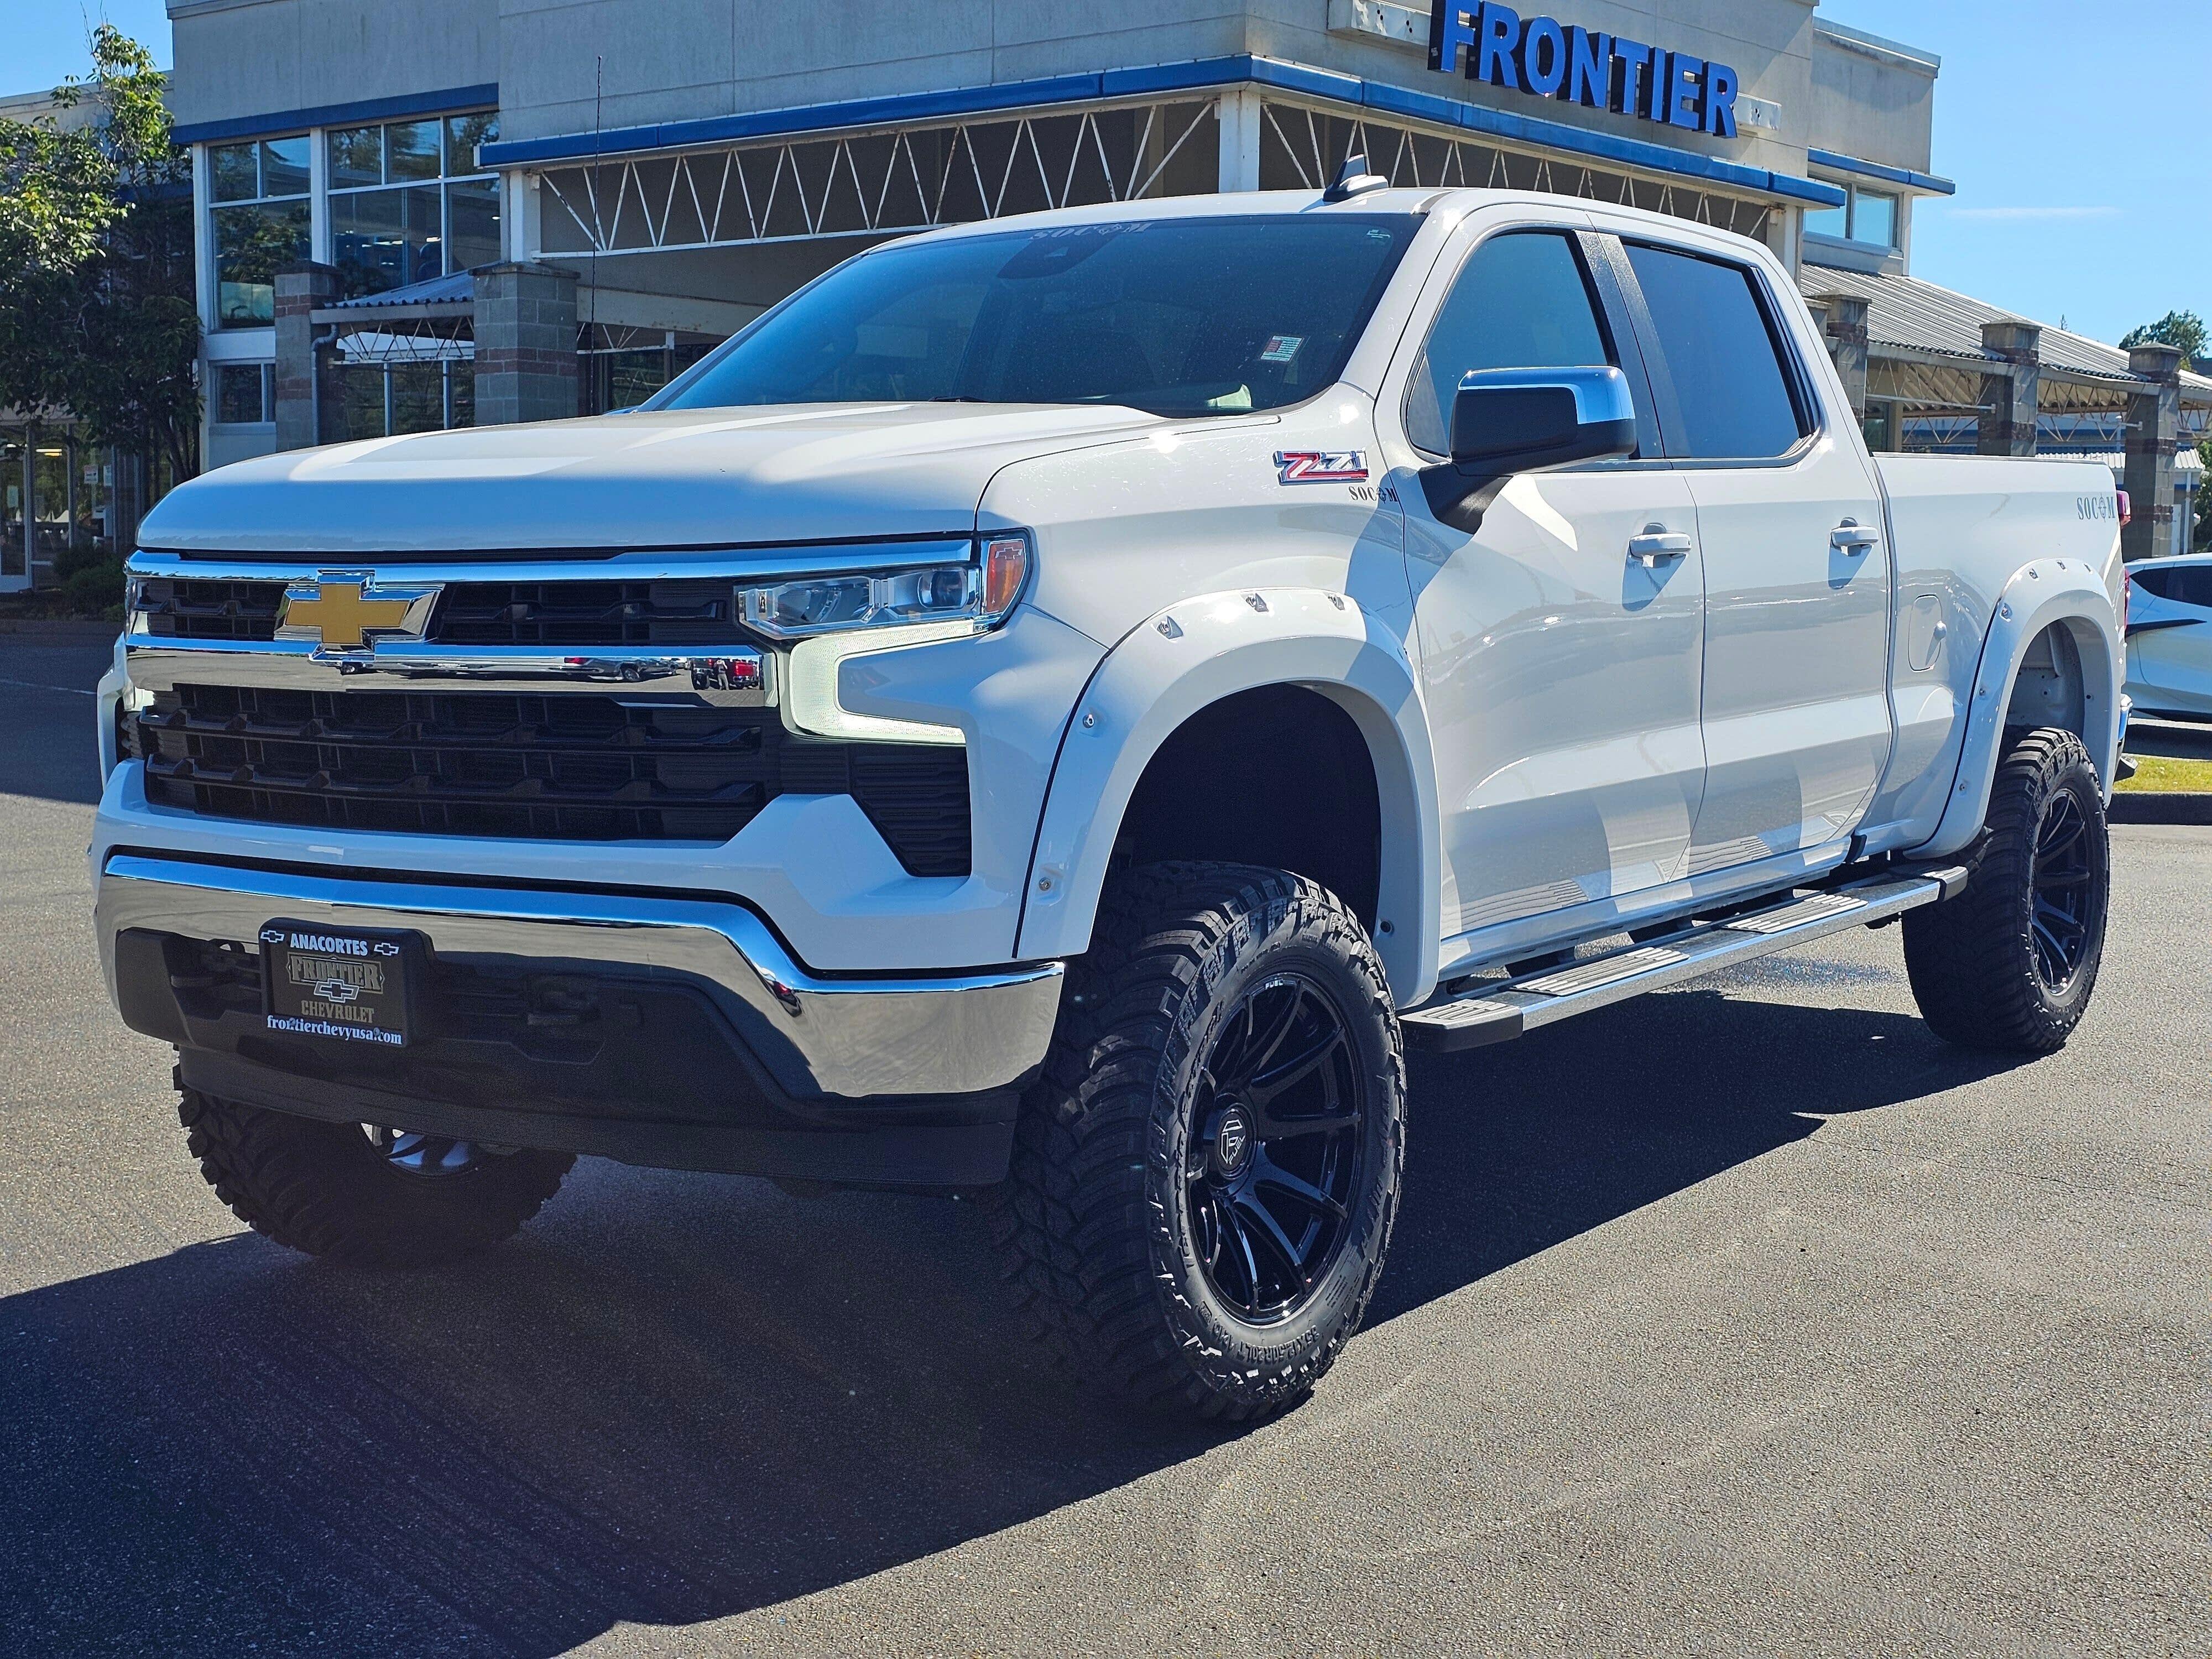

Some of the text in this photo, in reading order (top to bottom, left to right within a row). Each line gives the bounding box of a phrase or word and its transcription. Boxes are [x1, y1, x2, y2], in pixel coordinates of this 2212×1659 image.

[1428, 0, 1738, 138] FRONTIER
[1273, 451, 1369, 486] Z71
[290, 933, 368, 956] ANACORTES
[290, 956, 382, 990] FRONTIER
[1265, 977, 1284, 990] FUEL
[301, 1000, 374, 1023] CHEVROLET
[1228, 1135, 1245, 1165] FUEL
